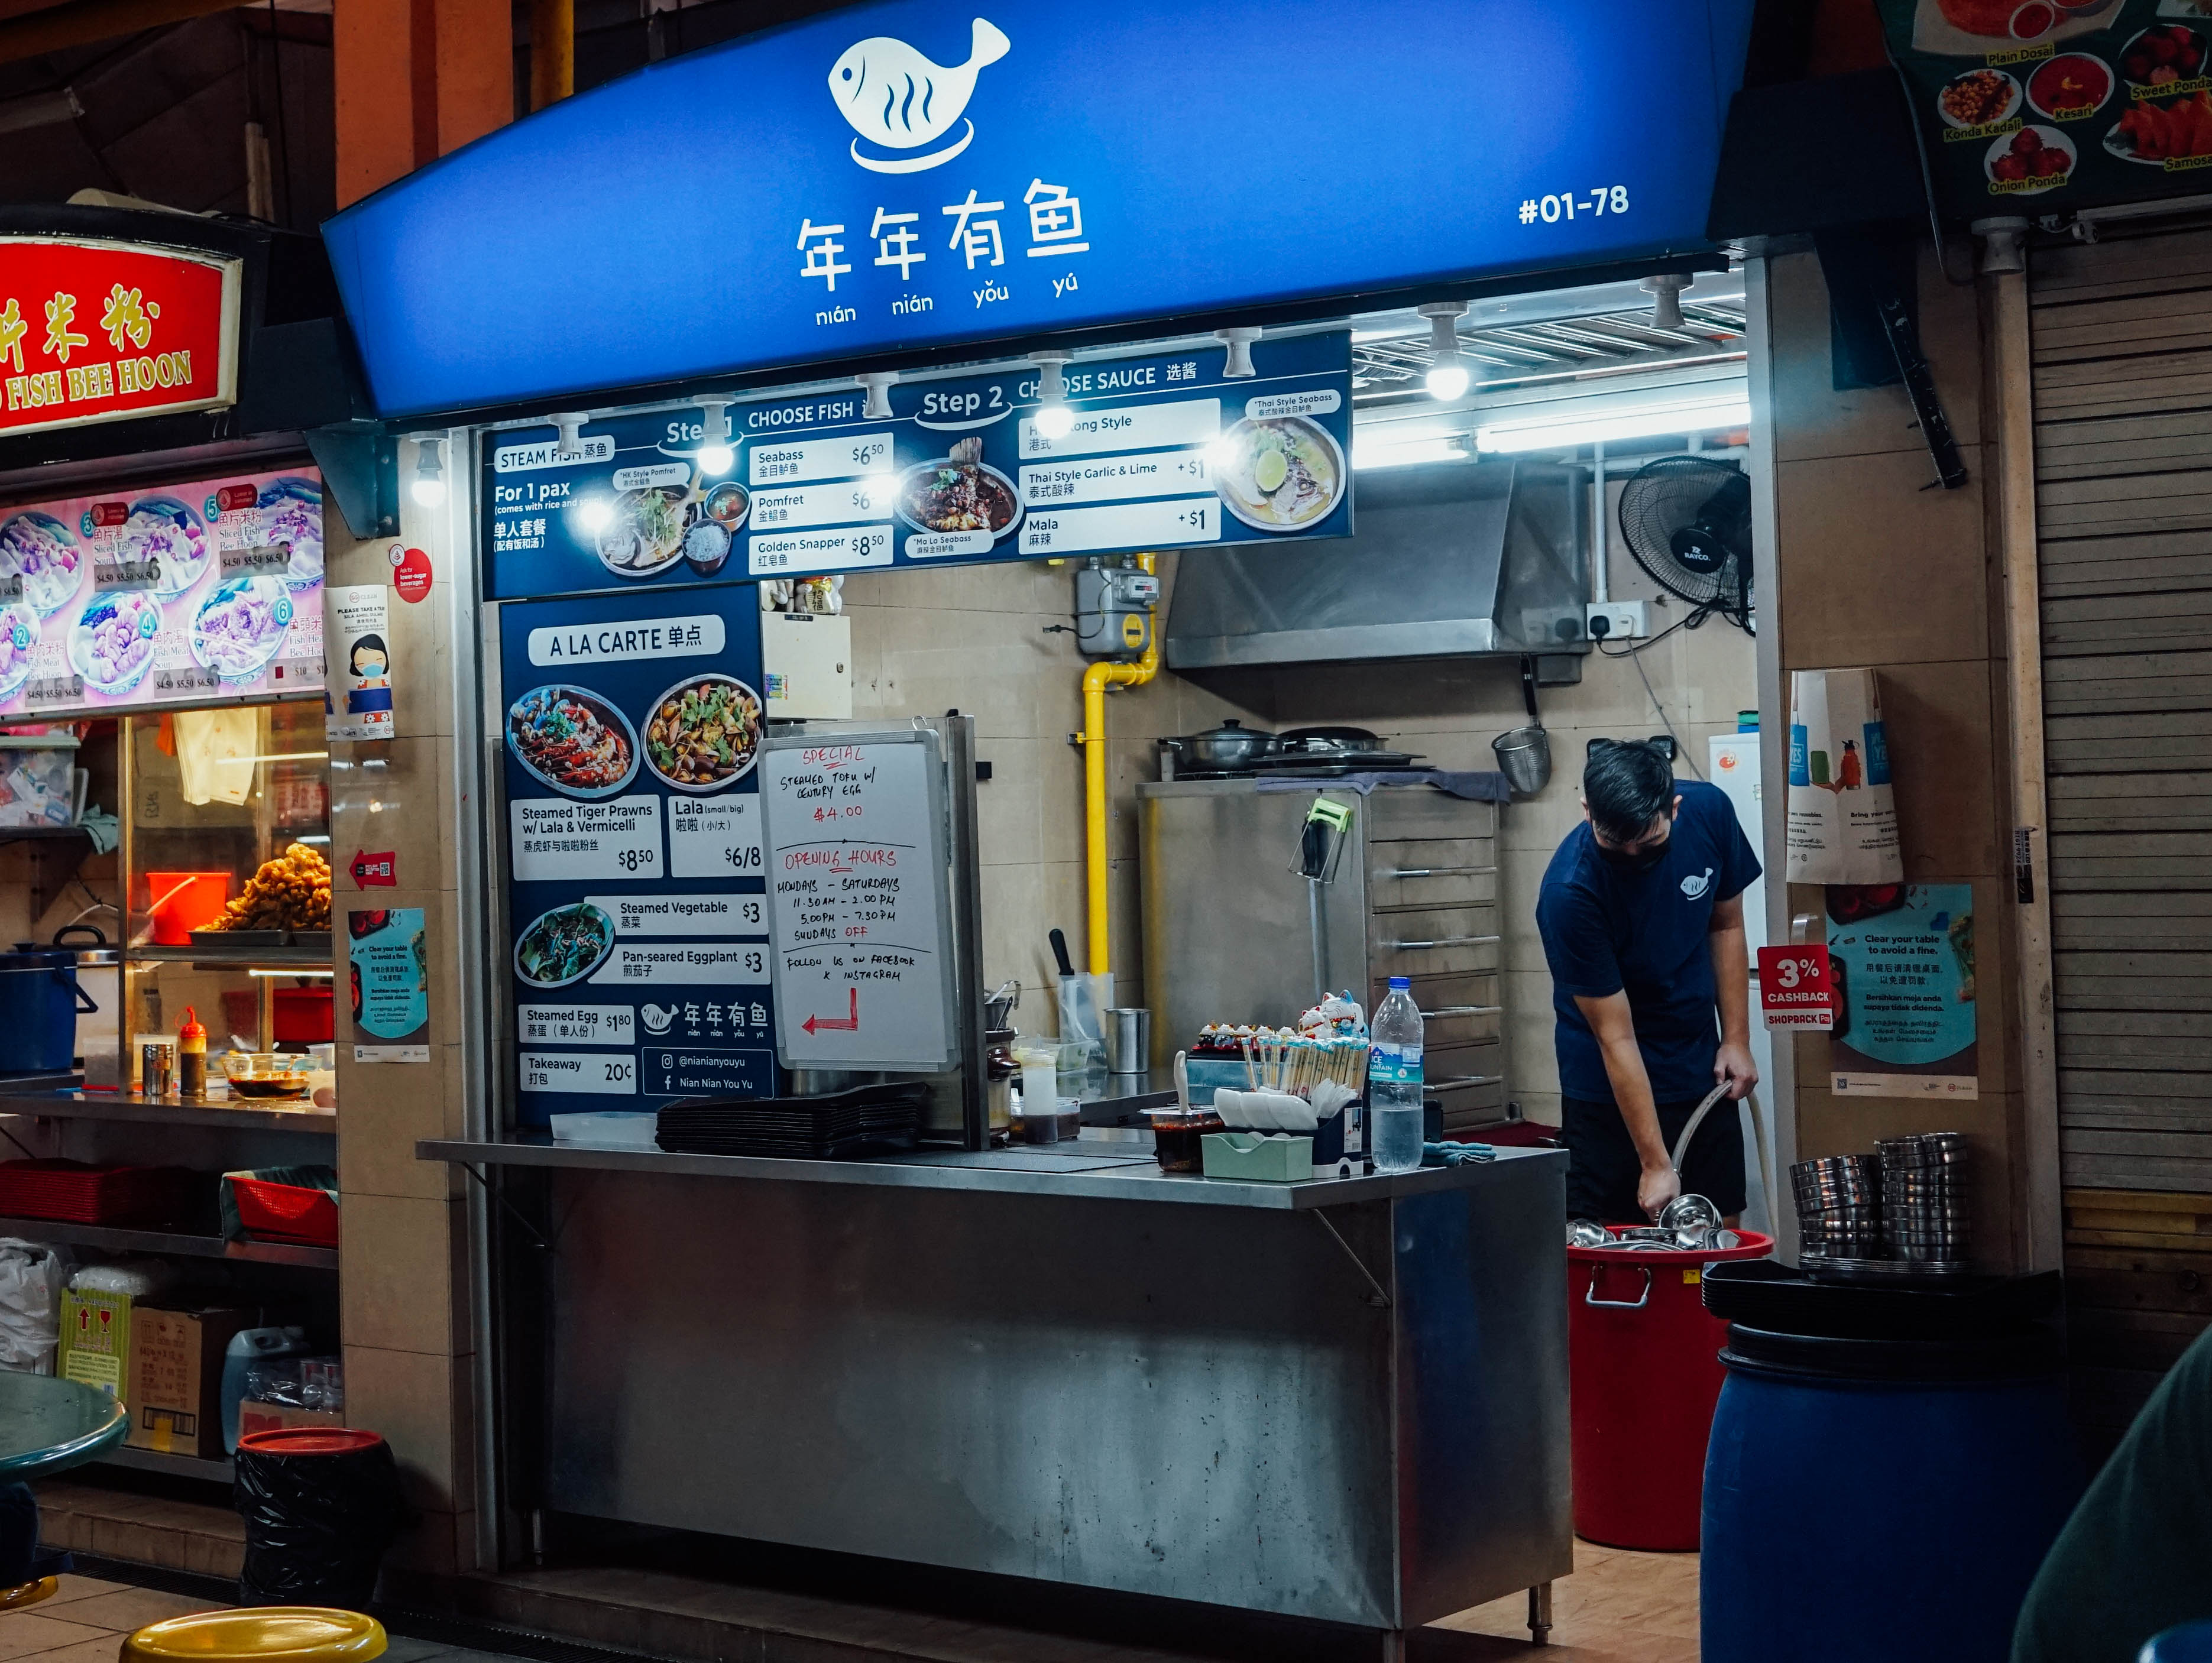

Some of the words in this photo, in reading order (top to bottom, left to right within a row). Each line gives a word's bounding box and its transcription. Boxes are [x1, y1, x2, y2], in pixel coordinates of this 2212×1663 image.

[1988, 51, 2017, 65] Plain
[2021, 46, 2054, 61] Dosai
[2133, 85, 2171, 98] Sweet
[2174, 77, 2212, 92] Ponda
[2055, 105, 2092, 119] Kesari
[1945, 127, 1982, 141] Konda
[1984, 120, 2022, 135] Kadali
[1990, 180, 2025, 194] Onion
[2028, 174, 2065, 189] Ponda
[1518, 185, 1629, 225] #01-78
[797, 178, 1090, 291] 年年有鱼
[892, 294, 933, 315] nián
[1053, 273, 1078, 298] yú
[5, 371, 64, 411] FISH
[66, 362, 114, 401] BEE
[117, 350, 192, 394] HOON
[1018, 374, 1092, 398] CHSE
[1097, 367, 1157, 390] SAUCE
[1167, 362, 1197, 382] 选酱
[924, 393, 980, 416] Step
[989, 385, 1003, 407] 2
[1277, 398, 1296, 407] Style
[1298, 394, 1332, 404] Seabass
[749, 407, 814, 428] CHOOSE
[819, 401, 853, 420] FISH
[1102, 416, 1132, 430] Style
[584, 443, 607, 459] 蒸鱼
[1029, 438, 1052, 452] 港式
[501, 449, 546, 468] STEAM
[759, 449, 804, 464] Seabass
[633, 470, 649, 479] Style
[651, 468, 676, 476] Pomfret
[1029, 472, 1052, 484] Thai
[1054, 469, 1081, 484] Style
[1084, 466, 1117, 479] Garlic
[1119, 466, 1126, 476] &
[1131, 463, 1157, 475] Lime
[1188, 458, 1205, 479] $1
[495, 486, 523, 502] For
[527, 483, 534, 499] 1
[539, 482, 571, 501] pax
[1029, 483, 1075, 498] 泰式酸辣
[495, 506, 523, 516] (comes
[525, 502, 543, 511] with
[545, 500, 560, 510] rice
[562, 498, 577, 508] and
[759, 494, 804, 508] Pomfret
[1029, 519, 1058, 531] Mala
[1190, 509, 1205, 531] $1
[219, 529, 242, 539] Sliced
[244, 526, 260, 536] Fish
[494, 518, 546, 539] 单人套餐
[95, 542, 115, 553] Sliced
[118, 540, 132, 551] Fish
[237, 540, 258, 549] Hoon
[758, 539, 796, 553] Golden
[799, 536, 846, 552] Snapper
[940, 535, 971, 543] Seabass
[1029, 533, 1051, 547] 麻辣
[223, 558, 241, 567] $4.50
[244, 556, 262, 565] $5.50
[265, 553, 283, 563] $6.50
[97, 574, 114, 583] $4.50
[117, 573, 134, 582] $5.50
[290, 634, 305, 645] Fish
[550, 636, 562, 656] A
[569, 634, 592, 655] LA
[598, 629, 662, 653] CARTE
[669, 624, 702, 647] 单点
[154, 647, 169, 657] Fish
[171, 646, 189, 655] Meat
[290, 648, 305, 657] Bee
[28, 659, 41, 668] Fish
[44, 658, 60, 667] Meat
[154, 659, 173, 669] Soup
[157, 680, 173, 689] $4.50
[177, 679, 193, 688] $5.50
[197, 678, 214, 687] $6.50
[65, 688, 81, 697] $6.50
[803, 745, 865, 764] SPECIAL
[780, 775, 823, 790] STEAMED
[833, 772, 857, 782] TOFU
[797, 786, 833, 799] CENTURY
[843, 784, 861, 795] EGG
[522, 807, 573, 820] Steamed
[576, 804, 605, 820] Tiger
[609, 805, 653, 816] Prawns
[676, 800, 703, 815] Lala
[814, 806, 862, 822] $4.00
[523, 822, 537, 835] w/
[540, 821, 563, 833] Lala
[566, 822, 575, 832] &
[577, 819, 636, 832] Vermicelli
[725, 846, 762, 869] $6/8
[785, 850, 840, 870] OPENING
[848, 850, 896, 866] HOURS
[778, 879, 818, 893] MONDAYS
[842, 878, 900, 892] SATURDAYS
[621, 902, 669, 914] Steamed
[672, 902, 728, 916] Vegetable
[743, 902, 760, 923] $3
[621, 916, 641, 929] 蒸菜
[795, 928, 836, 941] SUNDAYS
[846, 926, 868, 938] OFF
[1892, 936, 1913, 945] your
[1915, 935, 1940, 943] table
[1881, 946, 1907, 955] avoid
[1918, 946, 1938, 955] fine.
[623, 951, 684, 962] Pan-seared
[687, 951, 738, 965] Eggplant
[745, 952, 762, 973] $3
[787, 957, 822, 971] FOLLOW
[834, 957, 843, 966] US
[871, 955, 915, 965] FACEBOOK
[623, 964, 653, 977] 煎茄子
[844, 971, 901, 981] INSTAGRAM
[1777, 959, 1819, 988] 3%
[1768, 992, 1829, 1003] CASHBACK
[527, 1010, 574, 1022] Steamed
[578, 1011, 598, 1024] Egg
[684, 1001, 768, 1027] 年年有鱼
[1769, 1014, 1817, 1024] SHOPBACK
[679, 1056, 746, 1068] @nianianyouyu
[528, 1058, 582, 1071] Takeaway
[604, 1064, 632, 1082] 20¢
[529, 1072, 549, 1085] 打包
[680, 1078, 699, 1087] Nian
[702, 1078, 721, 1088] Nian
[723, 1079, 740, 1088] You
[741, 1080, 753, 1089] Yu
